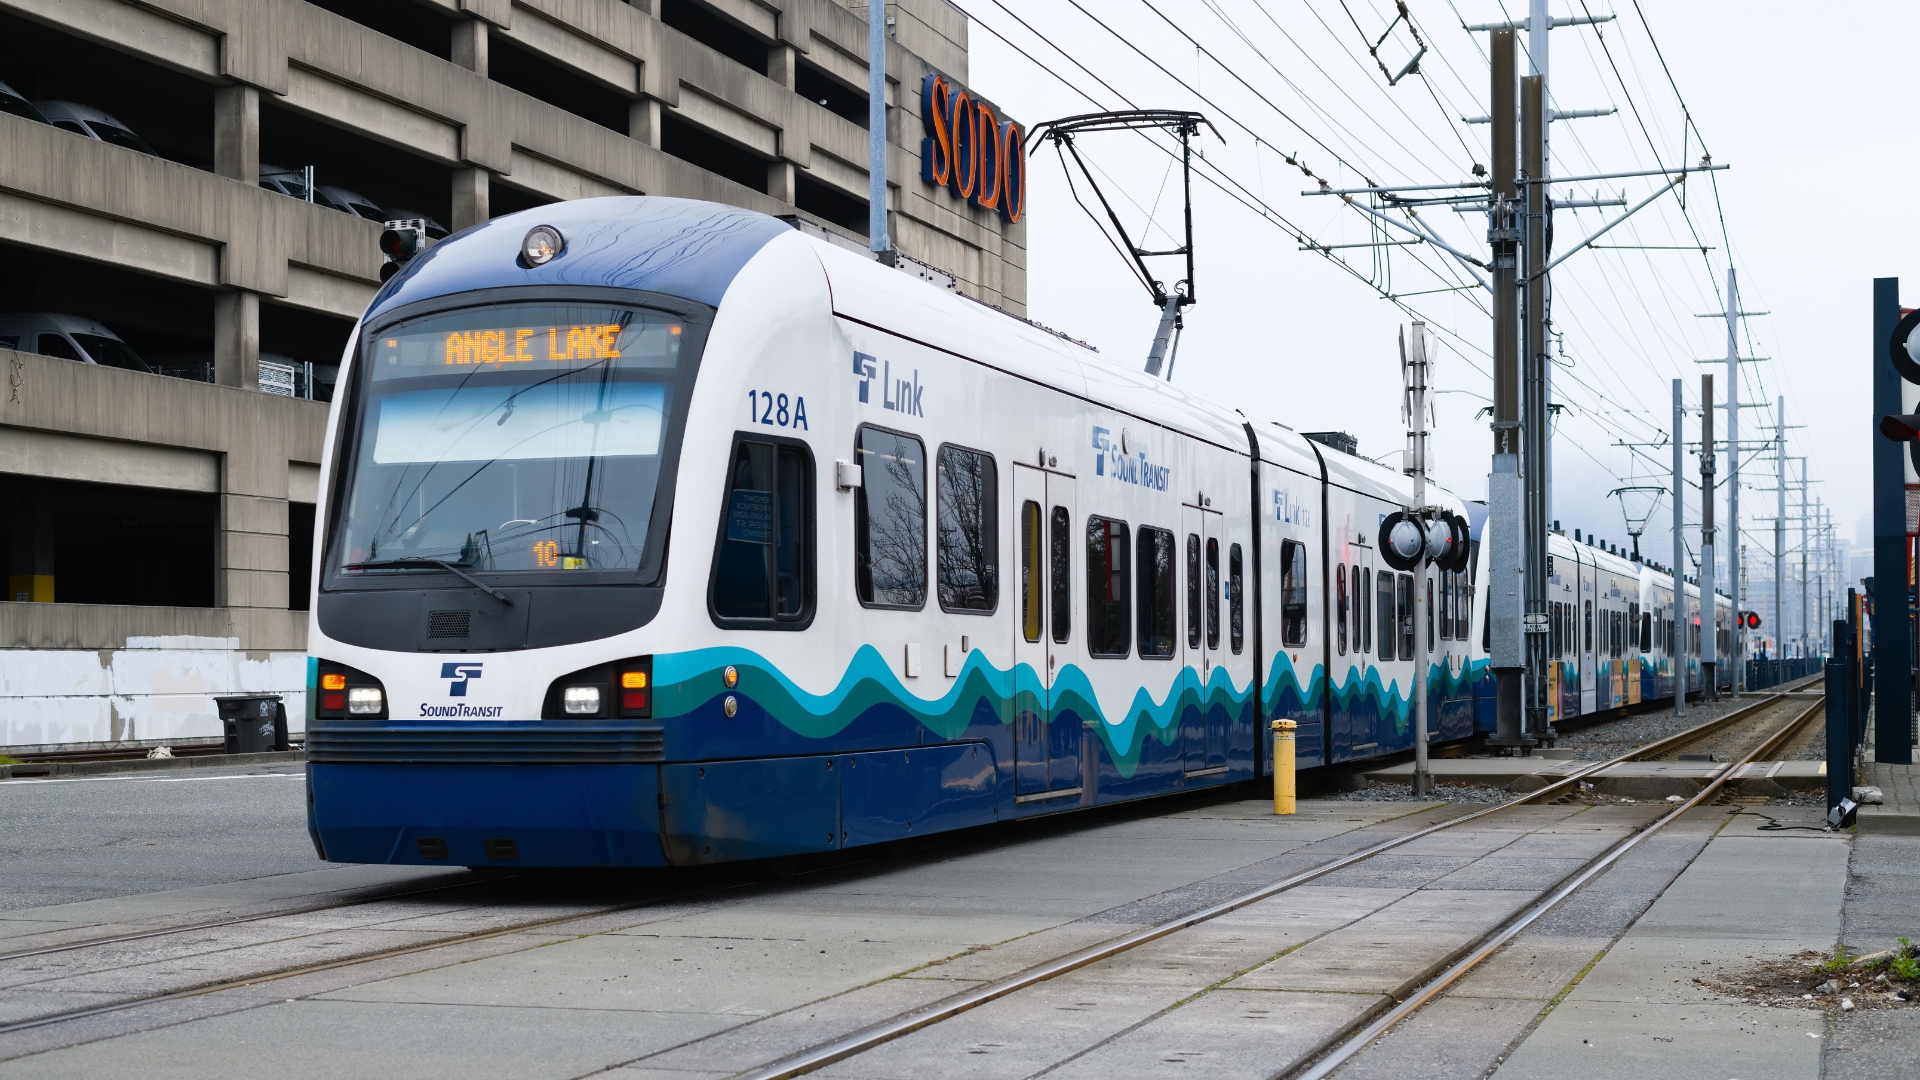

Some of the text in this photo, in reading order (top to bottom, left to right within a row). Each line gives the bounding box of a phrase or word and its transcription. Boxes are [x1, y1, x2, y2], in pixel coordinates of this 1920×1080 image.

[922, 74, 1025, 224] SODO
[446, 325, 621, 365] ANGLE LAKE
[748, 389, 809, 431] 128A
[883, 360, 924, 418] Link
[533, 540, 557, 567] 10
